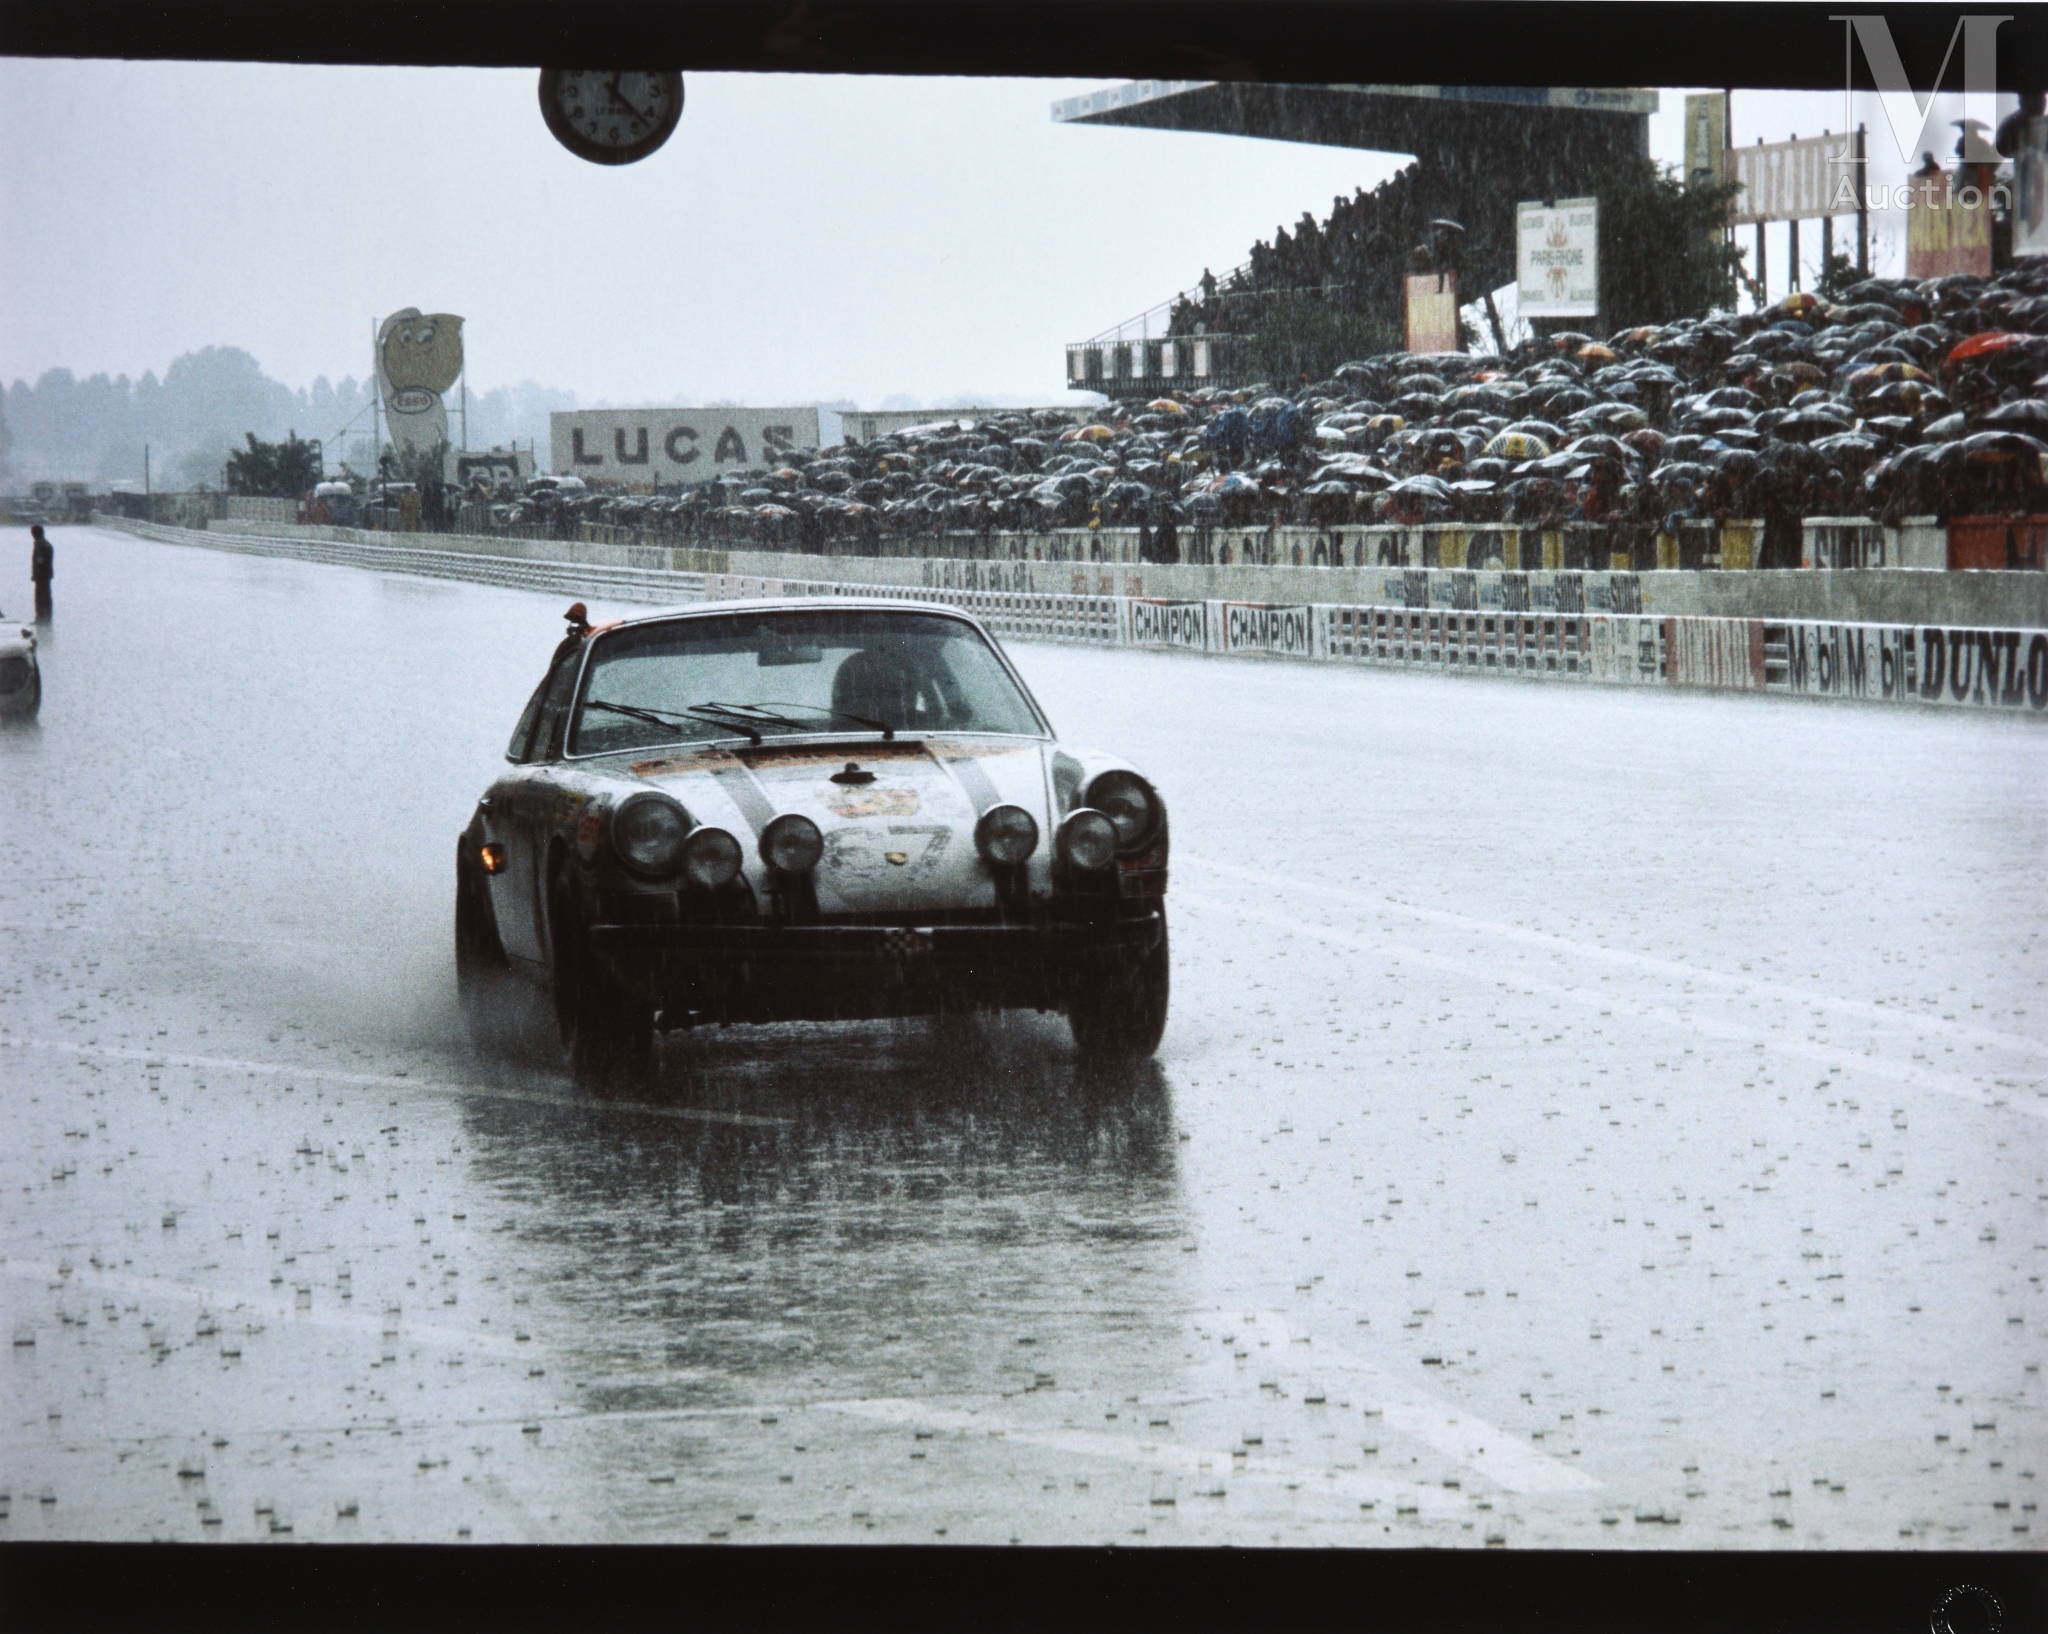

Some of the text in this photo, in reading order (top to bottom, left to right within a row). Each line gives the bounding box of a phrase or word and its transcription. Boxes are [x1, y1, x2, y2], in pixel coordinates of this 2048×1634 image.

[572, 424, 794, 465] LUCAS
[1135, 605, 1202, 645] CHAMPION
[1230, 608, 1305, 652] CHAMPION
[1787, 624, 1840, 694] Mobil
[1846, 627, 1905, 702] Mobil
